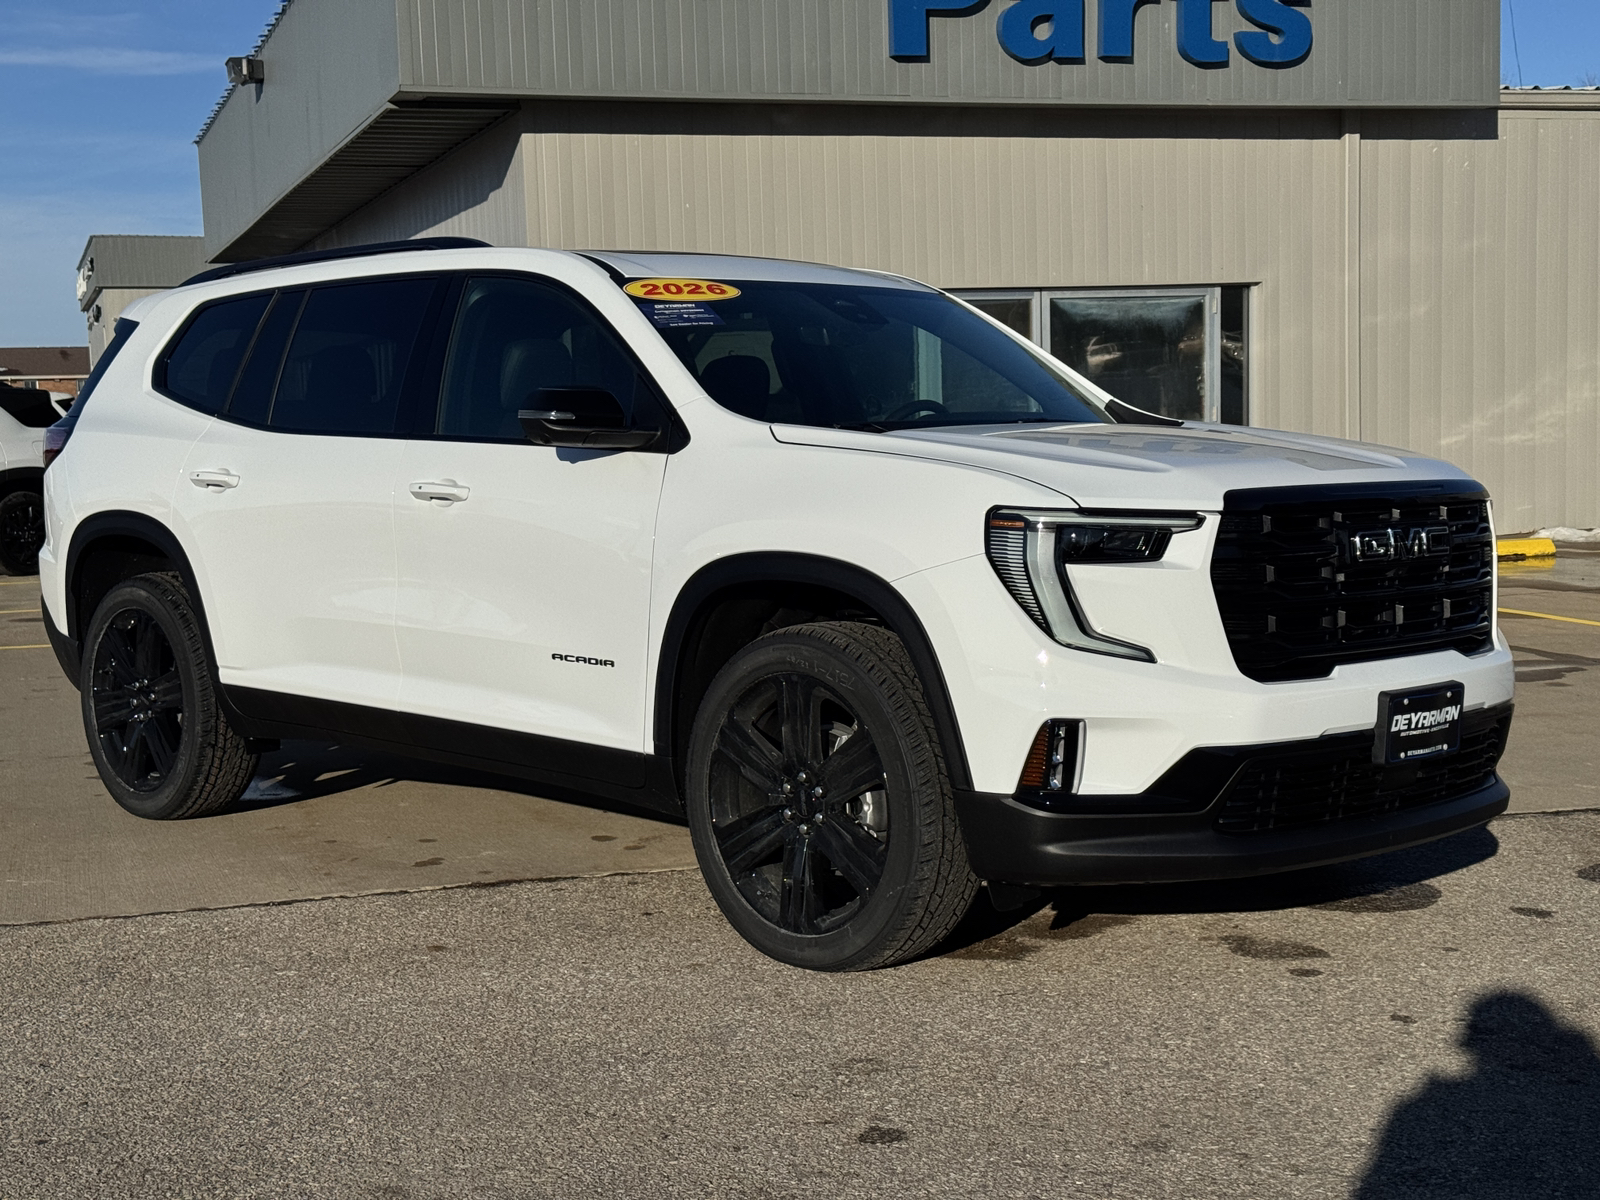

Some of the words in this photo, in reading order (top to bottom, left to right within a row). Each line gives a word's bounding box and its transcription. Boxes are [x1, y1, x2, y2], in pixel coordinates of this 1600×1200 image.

[639, 283, 729, 295] 2026
[1350, 526, 1449, 562] GMC
[551, 653, 615, 667] ACADIA
[1391, 704, 1461, 732] DEYARMAN
